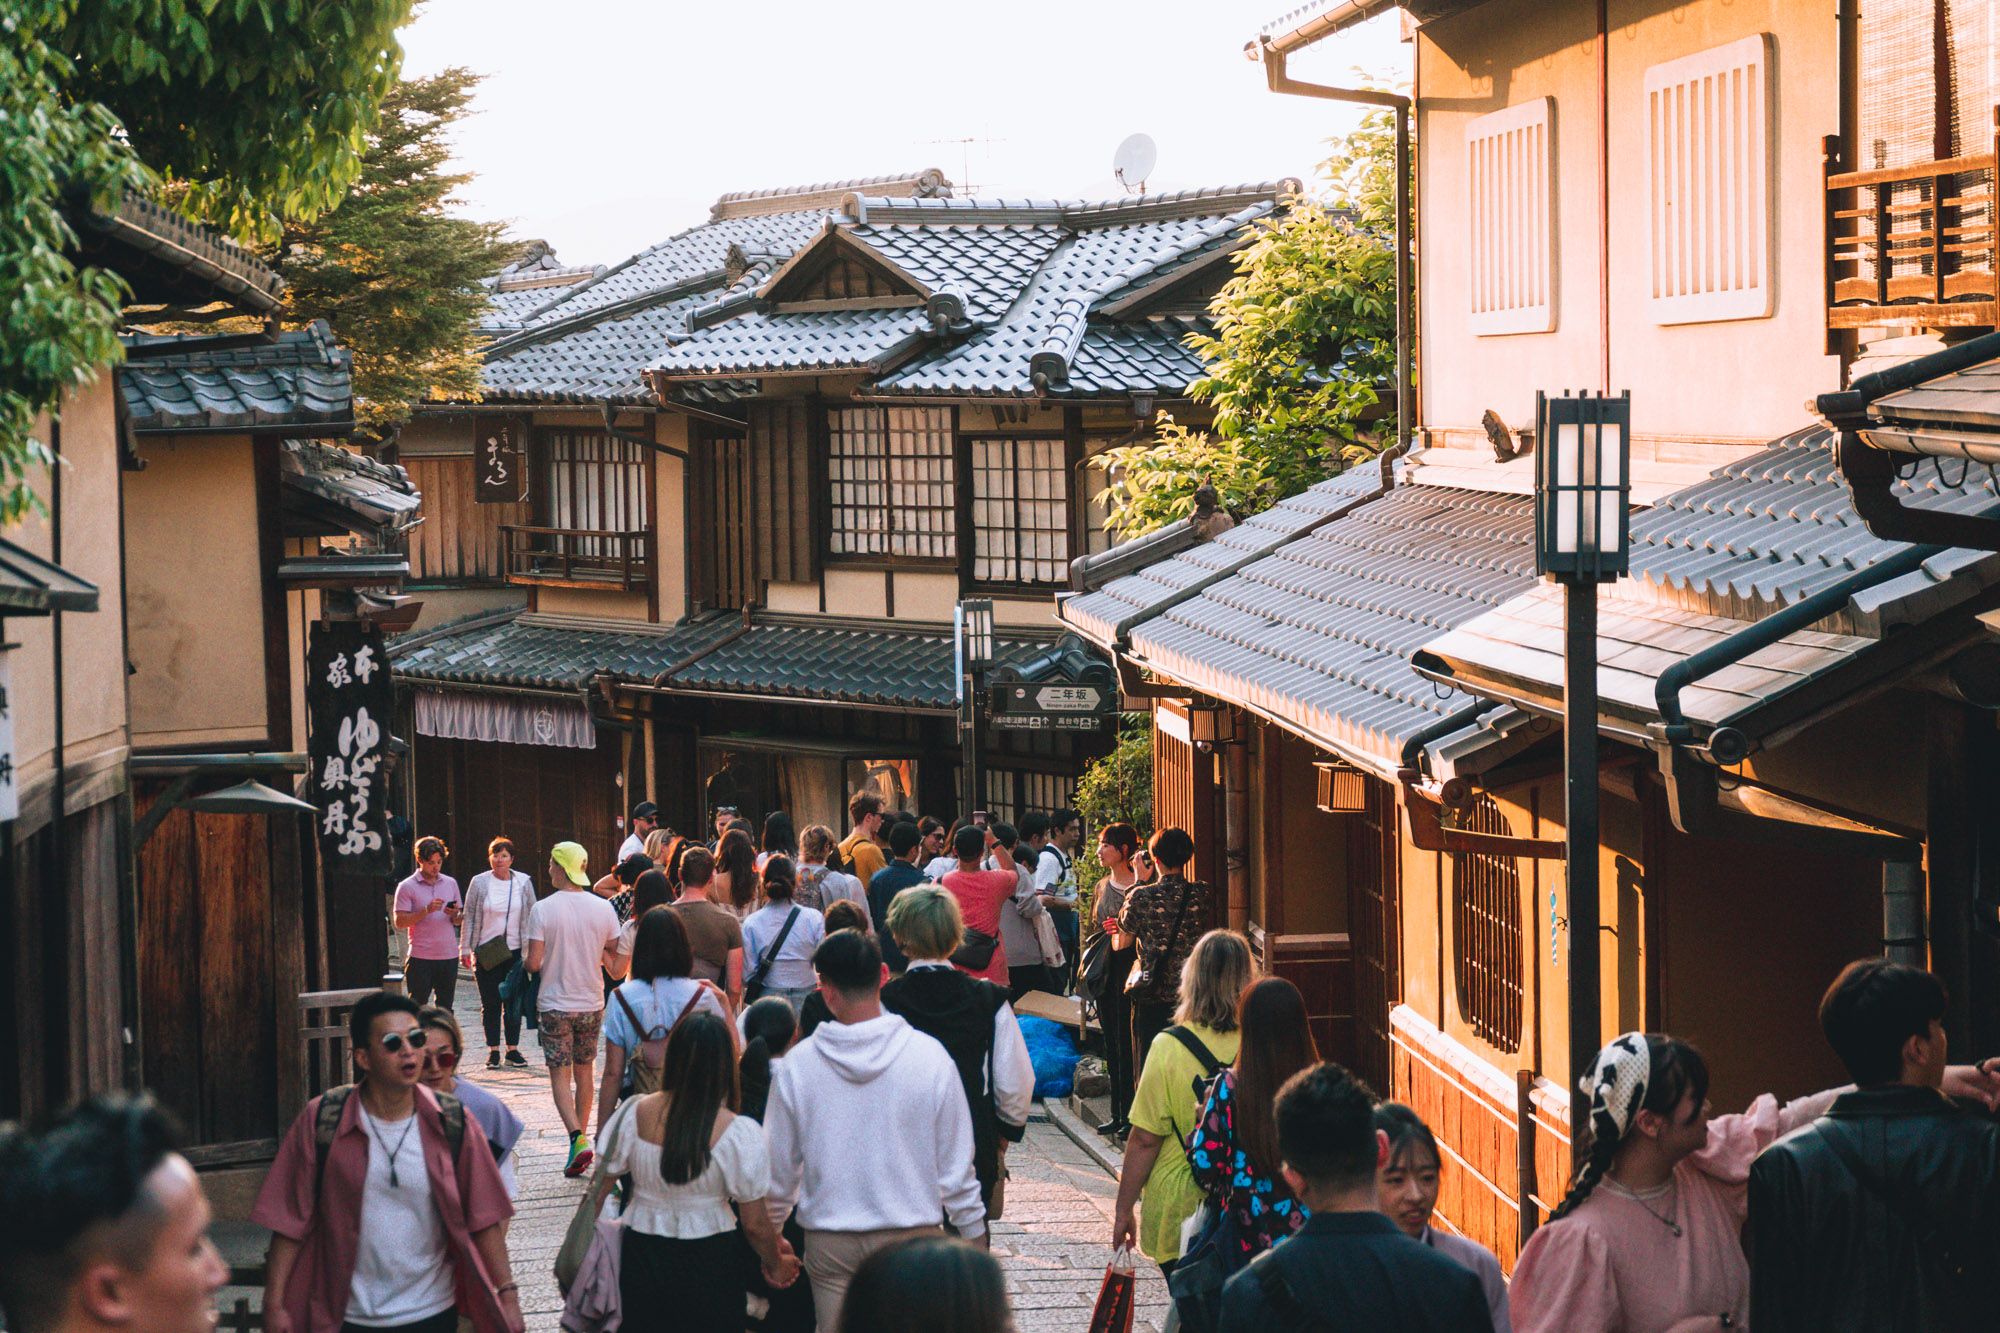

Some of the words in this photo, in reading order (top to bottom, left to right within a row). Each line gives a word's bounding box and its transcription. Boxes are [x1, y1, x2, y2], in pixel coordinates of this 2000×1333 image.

[1050, 689, 1087, 700] 二年坂
[320, 755, 349, 836] 奥丹
[338, 706, 382, 855] ゆどうふ
